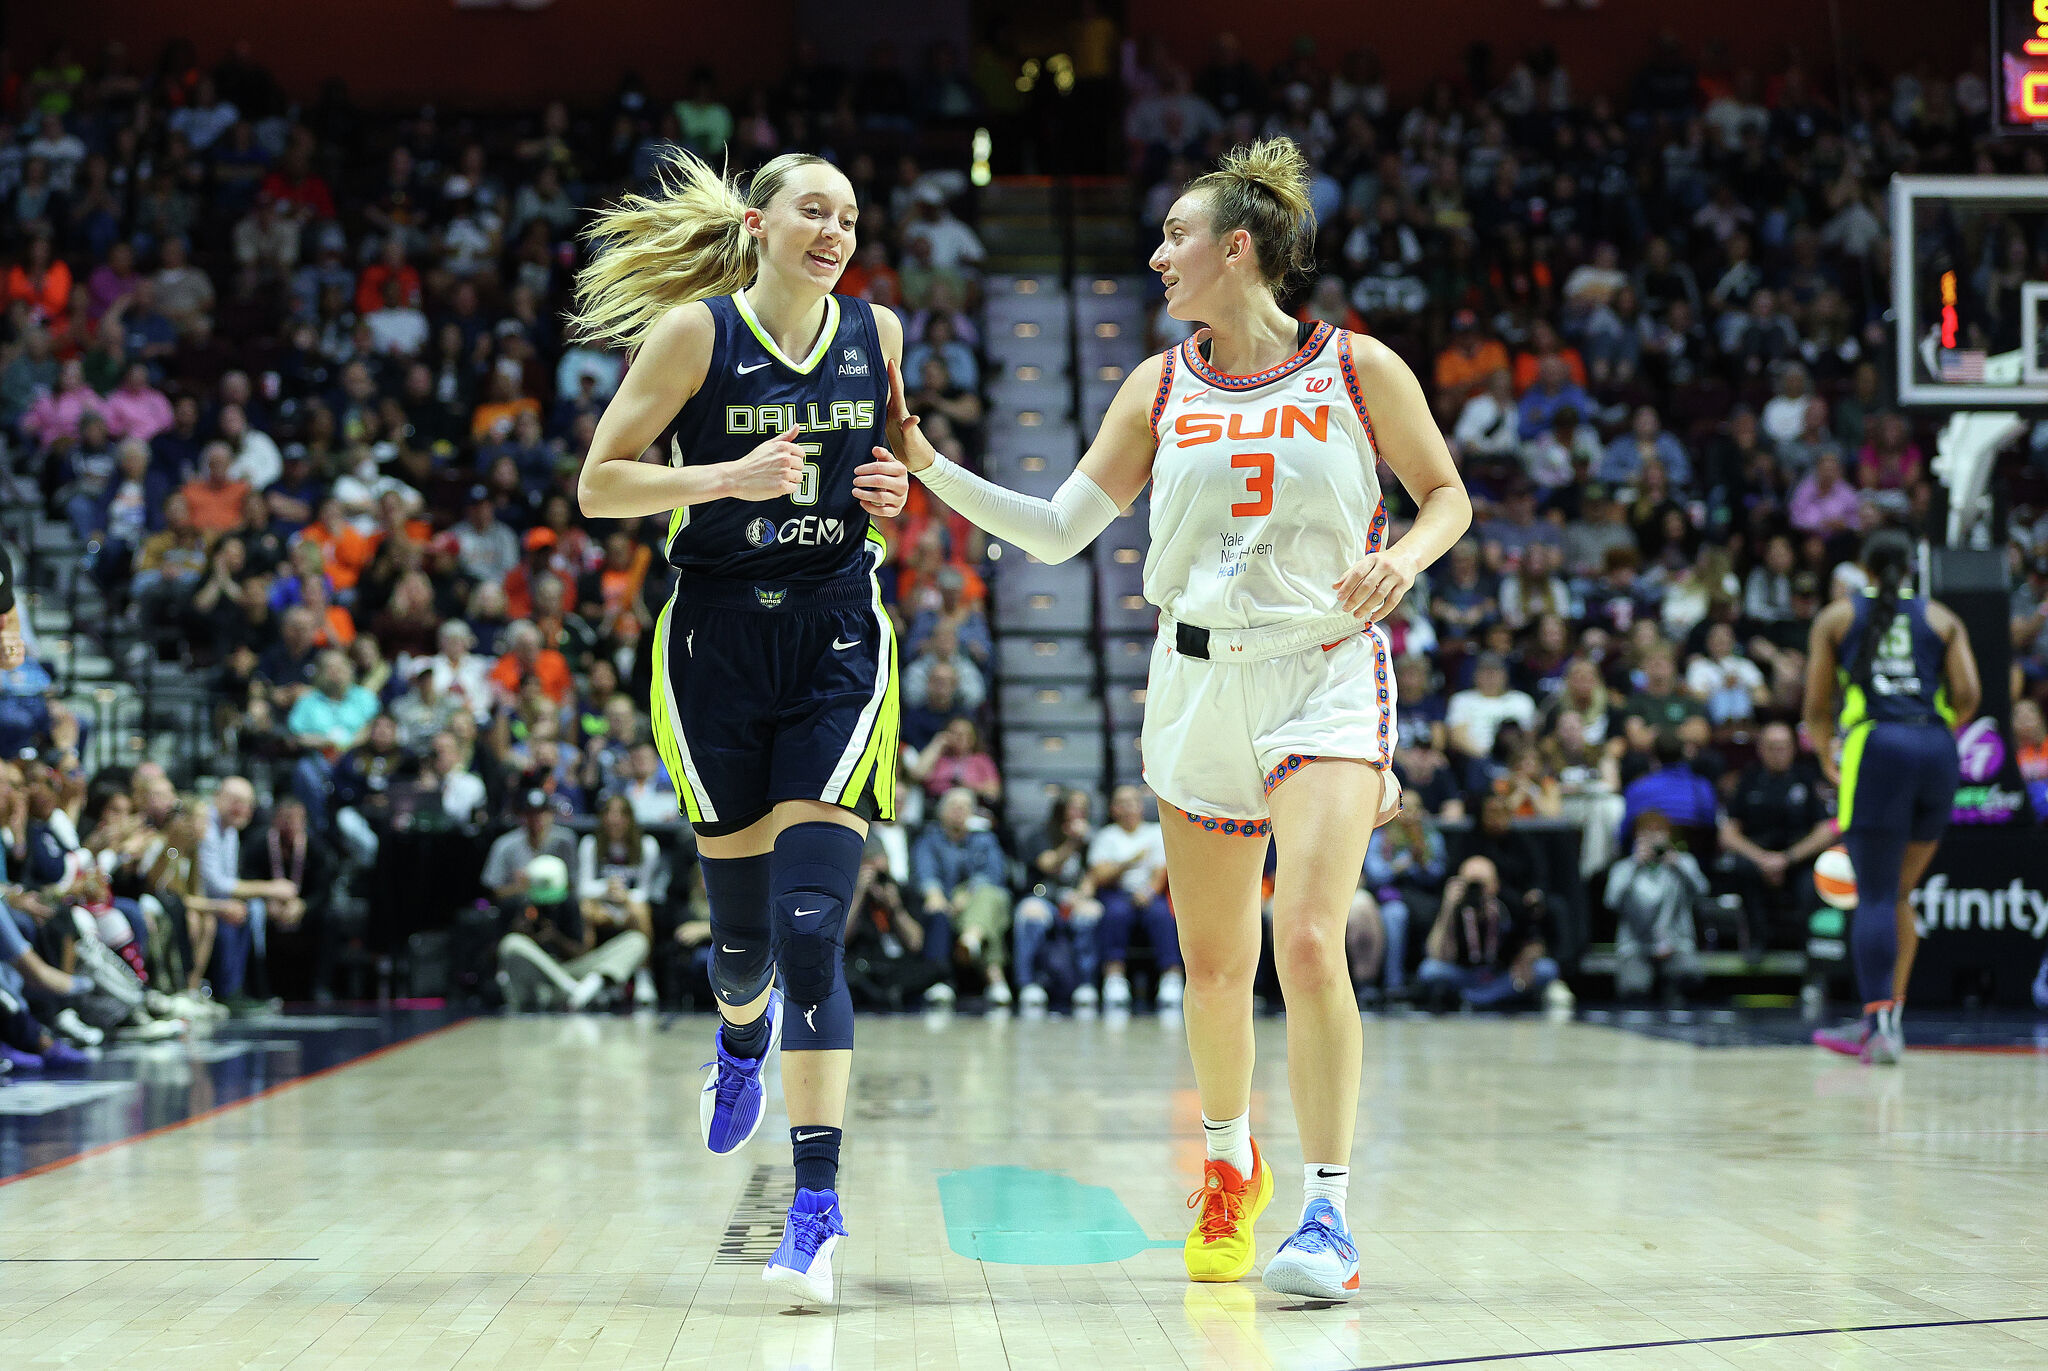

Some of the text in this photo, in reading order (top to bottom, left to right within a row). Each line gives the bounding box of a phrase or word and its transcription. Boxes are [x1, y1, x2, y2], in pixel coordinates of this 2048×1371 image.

[838, 363, 869, 376] Albert
[726, 400, 875, 434] DALLAS
[1175, 405, 1330, 449] SUN
[790, 442, 823, 506] 5
[1231, 453, 1275, 517] 3
[777, 515, 845, 546] GEM
[1220, 532, 1244, 547] Yale
[1239, 543, 1273, 560] Hven
